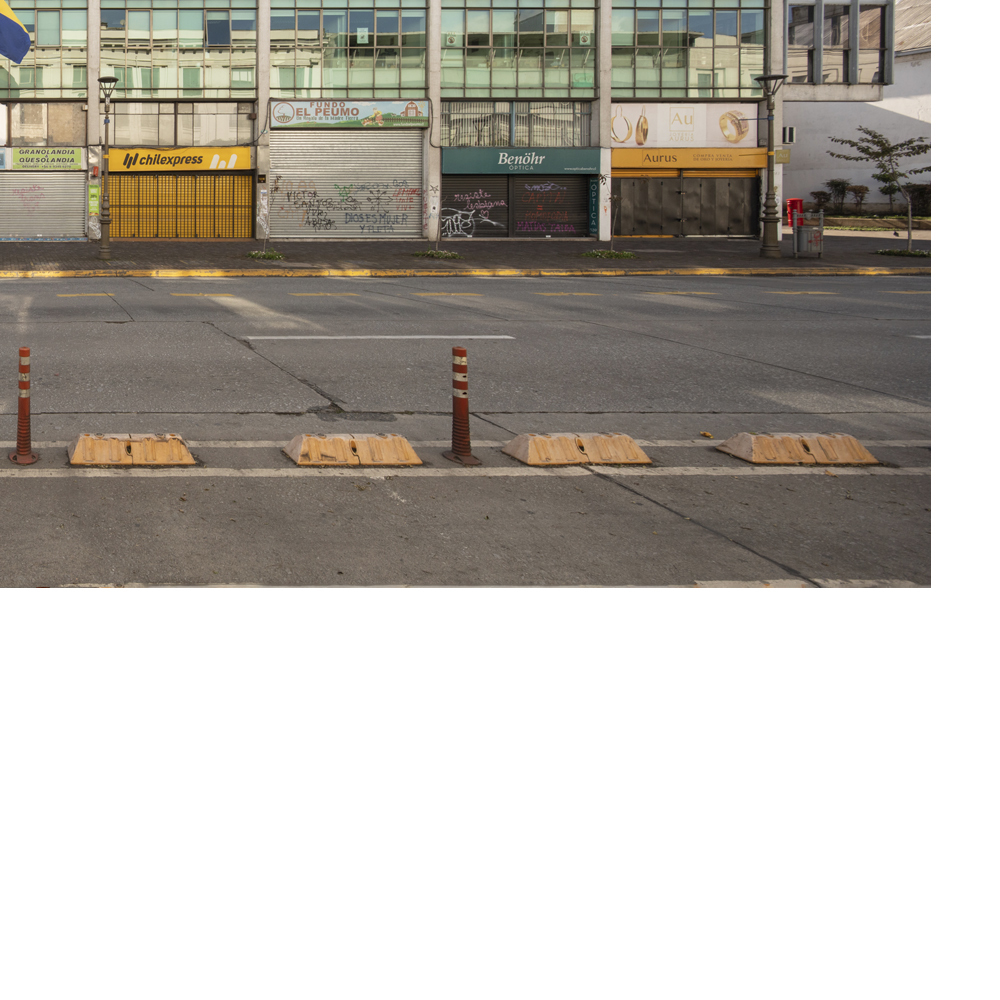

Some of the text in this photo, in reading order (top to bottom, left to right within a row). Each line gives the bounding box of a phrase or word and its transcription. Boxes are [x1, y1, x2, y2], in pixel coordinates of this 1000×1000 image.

[296, 108, 359, 116] EL PEUMO
[672, 112, 693, 125] Au
[139, 154, 203, 167] chilexpress
[498, 152, 545, 165] Benöhr
[643, 153, 677, 162] Aurus
[345, 213, 408, 225] DIOS ES MUJER
